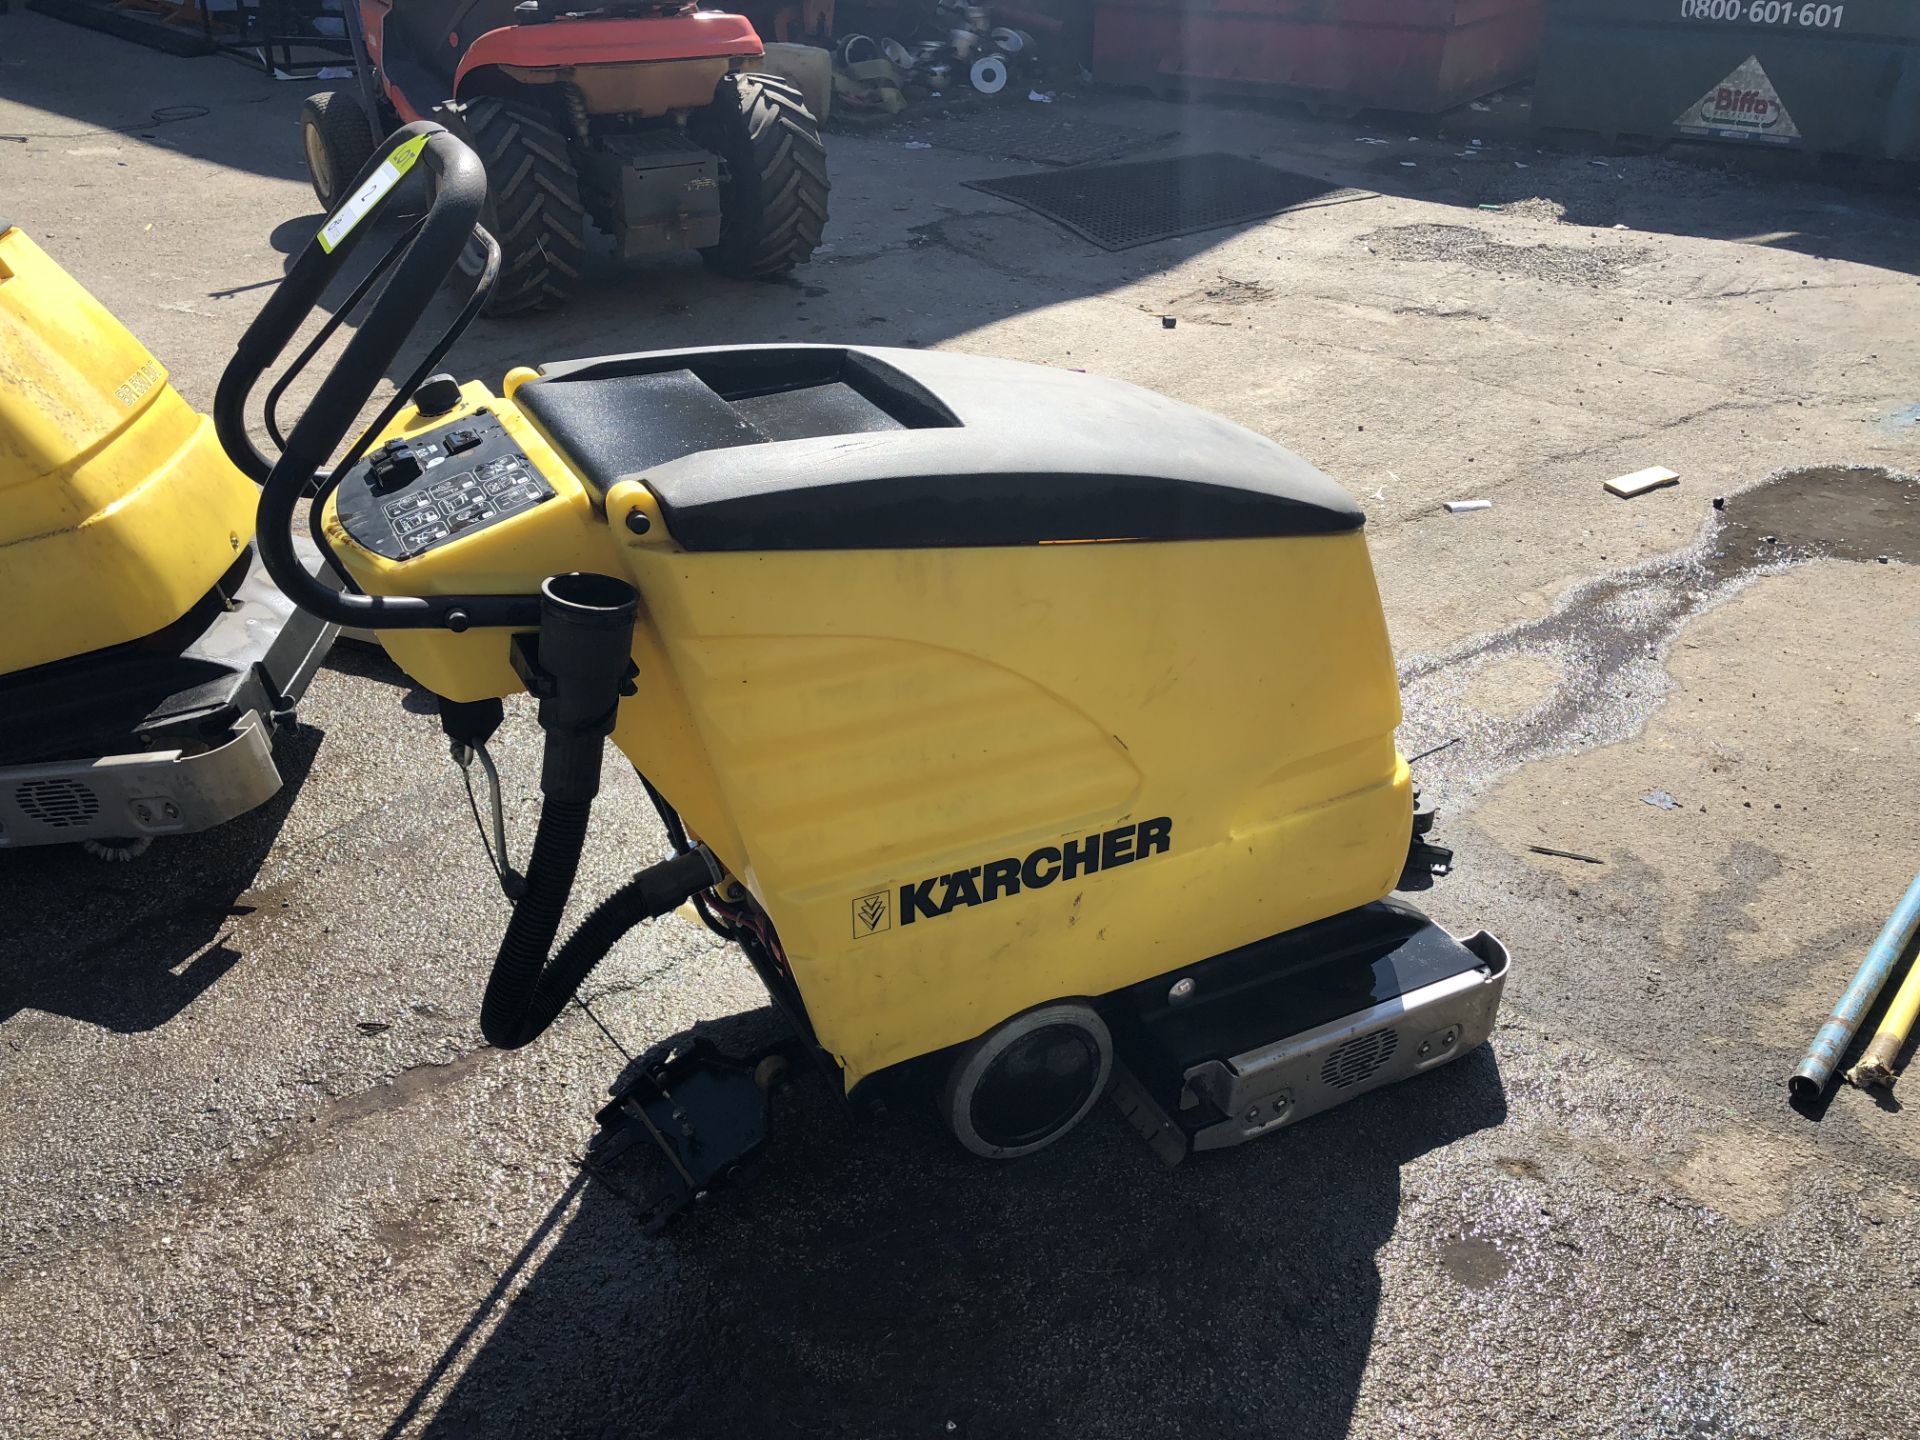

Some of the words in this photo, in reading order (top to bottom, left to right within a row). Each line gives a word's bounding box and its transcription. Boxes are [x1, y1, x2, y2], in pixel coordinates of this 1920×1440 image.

[1715, 87, 1768, 115] Biffa
[393, 145, 416, 168] LOT
[900, 816, 1172, 926] KÄRCHER
